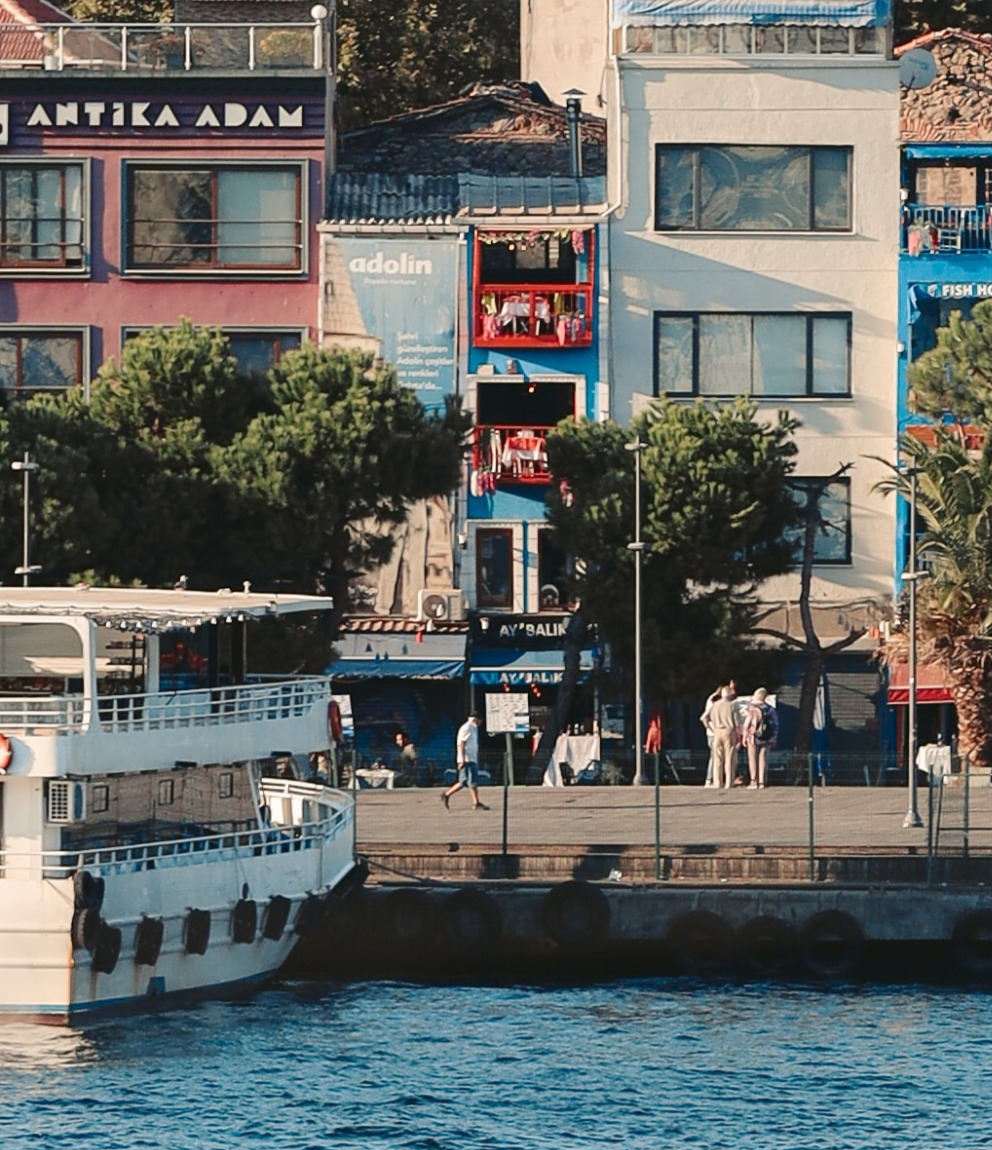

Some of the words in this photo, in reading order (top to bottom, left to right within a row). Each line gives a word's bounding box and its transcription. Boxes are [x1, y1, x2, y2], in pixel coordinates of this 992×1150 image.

[195, 103, 303, 127] ADAM
[348, 251, 432, 274] adolin
[942, 283, 973, 297] FISH
